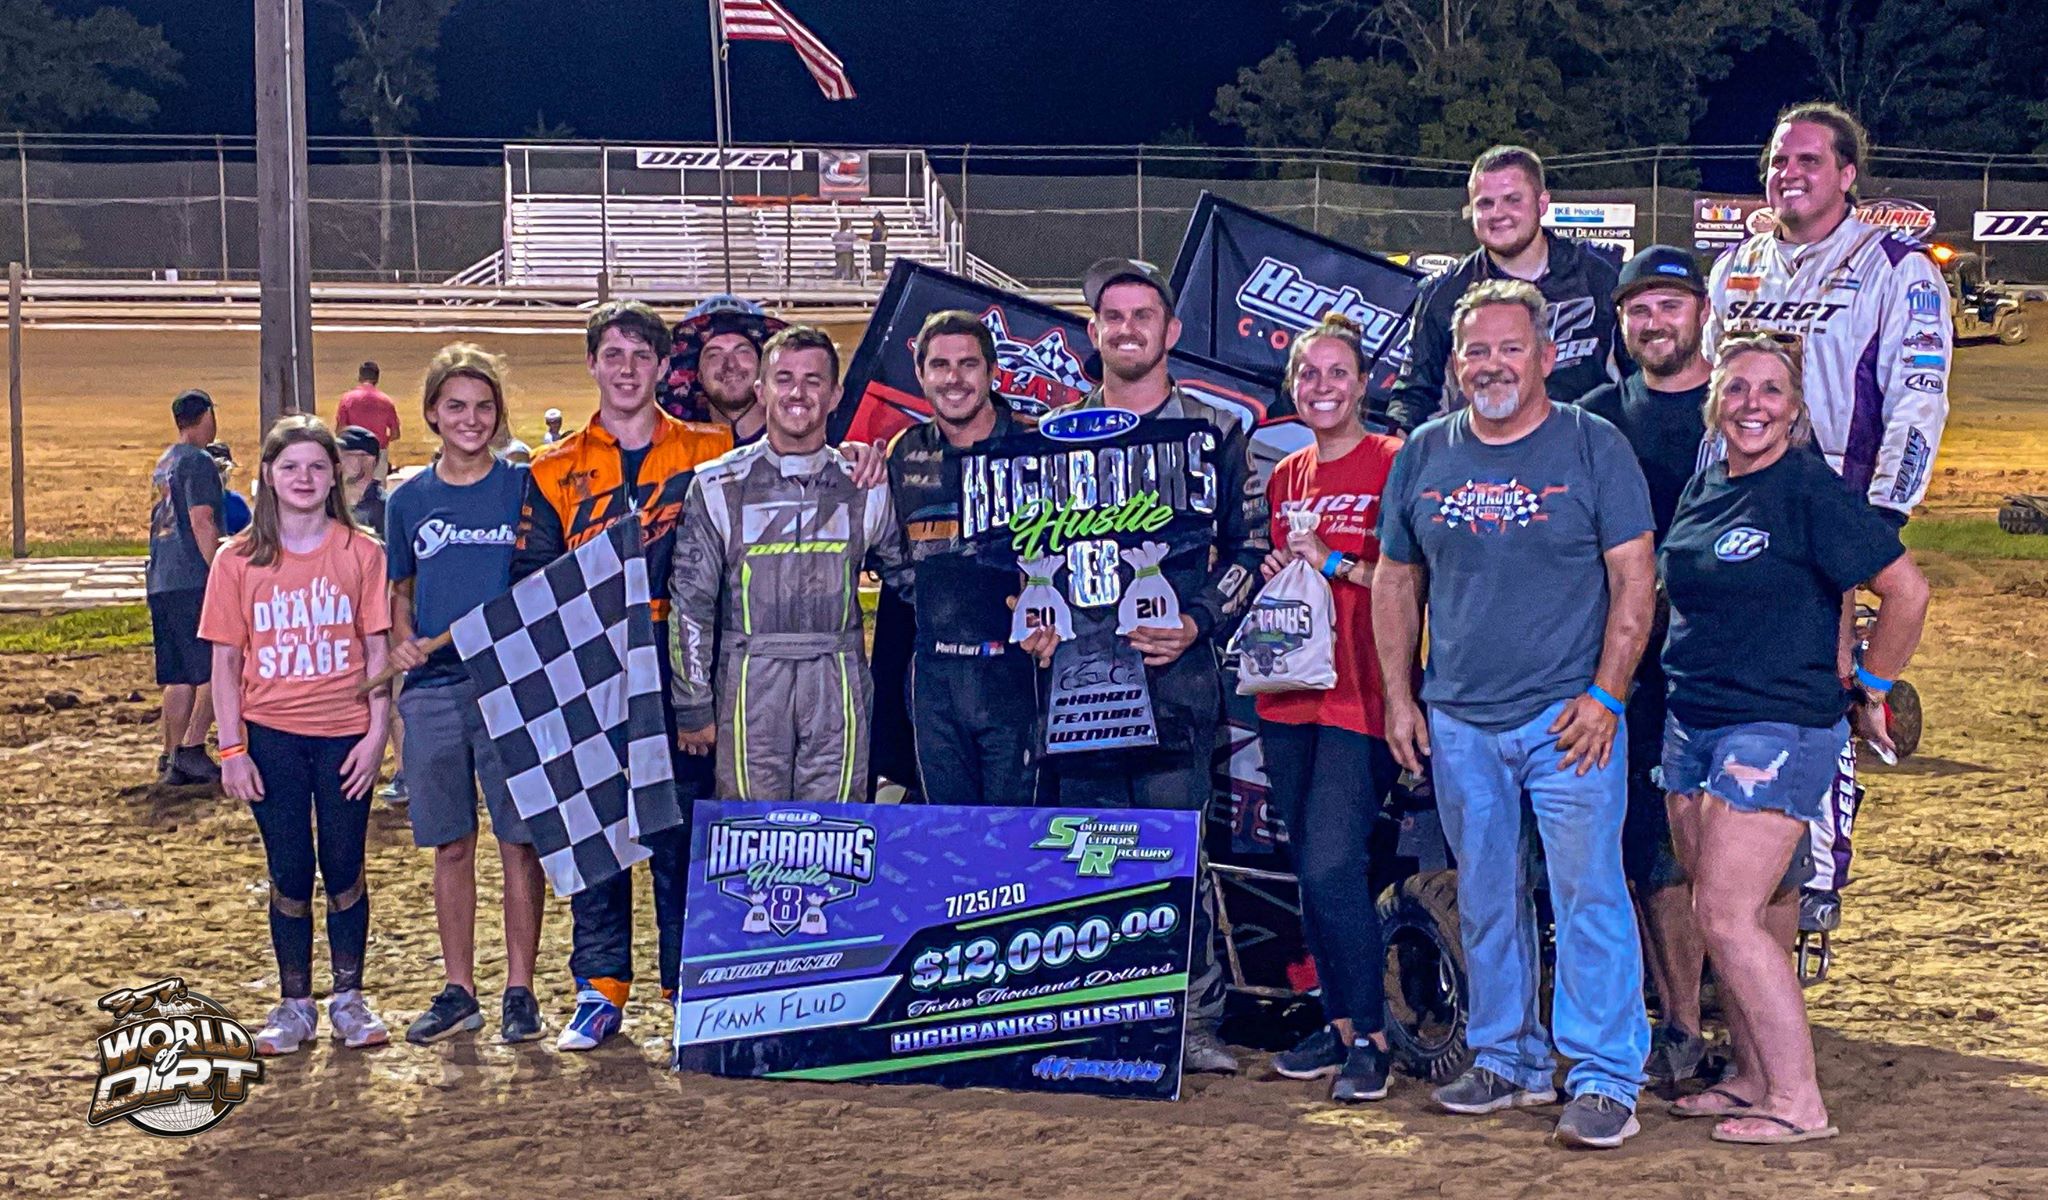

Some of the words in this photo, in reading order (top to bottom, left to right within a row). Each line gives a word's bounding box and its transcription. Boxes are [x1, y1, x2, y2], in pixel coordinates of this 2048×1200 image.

[641, 151, 798, 167] DRIVEN
[1727, 301, 1850, 322] SELECT
[960, 430, 1218, 539] HIGHBANKS
[1458, 490, 1524, 506] SPRAGUE
[413, 518, 517, 559] Sheesh
[1008, 490, 1174, 560] Hustle
[1067, 540, 1121, 608] 8
[254, 594, 353, 632] DRAMA
[1025, 606, 1056, 628] 20
[1135, 597, 1166, 619] 20
[258, 639, 351, 679] STAGE
[1049, 725, 1151, 743] WINNER
[1053, 707, 1145, 725] FEATURE
[768, 812, 818, 823] ENGLER
[708, 825, 875, 882] HIGHBANKS
[747, 860, 831, 891] Hustle
[771, 885, 802, 923] 8
[945, 883, 1026, 918] 7/25/20
[911, 905, 1177, 988] $12,000.00
[698, 961, 776, 984] FEATURE
[774, 953, 844, 975] WINNER
[976, 978, 1080, 1007] Thousand
[1083, 961, 1175, 988] Dollars
[695, 1000, 766, 1038] FRANK
[892, 1014, 1056, 1052] HIGHBANKS
[1061, 997, 1175, 1029] HUSTLE
